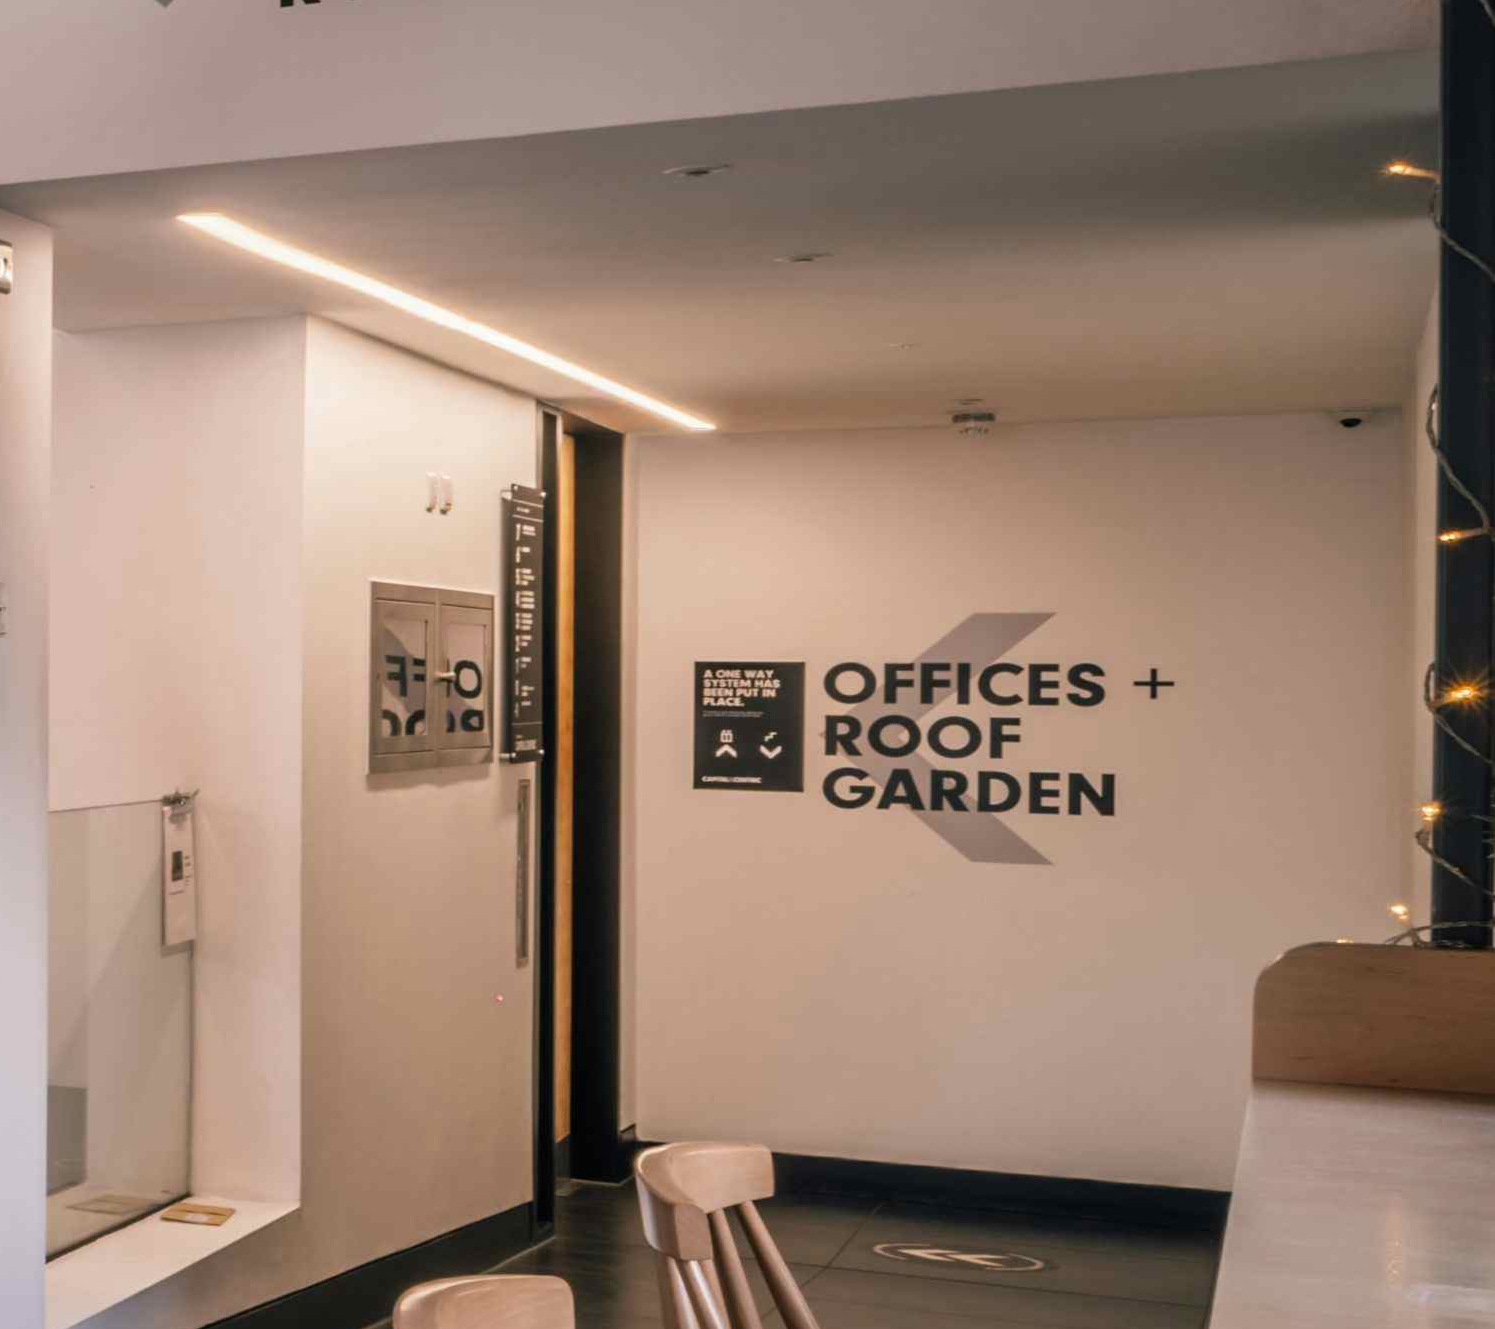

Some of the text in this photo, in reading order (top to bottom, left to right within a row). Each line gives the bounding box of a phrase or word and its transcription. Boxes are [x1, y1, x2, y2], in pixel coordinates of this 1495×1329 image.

[703, 669, 775, 679] A ONE WAY
[703, 679, 781, 689] SYSTEM HAS
[824, 662, 1175, 707] OFFICES +
[703, 688, 777, 698] BEEN PUT IN
[824, 714, 1022, 760] ROOF
[822, 767, 1116, 816] GARDEN
